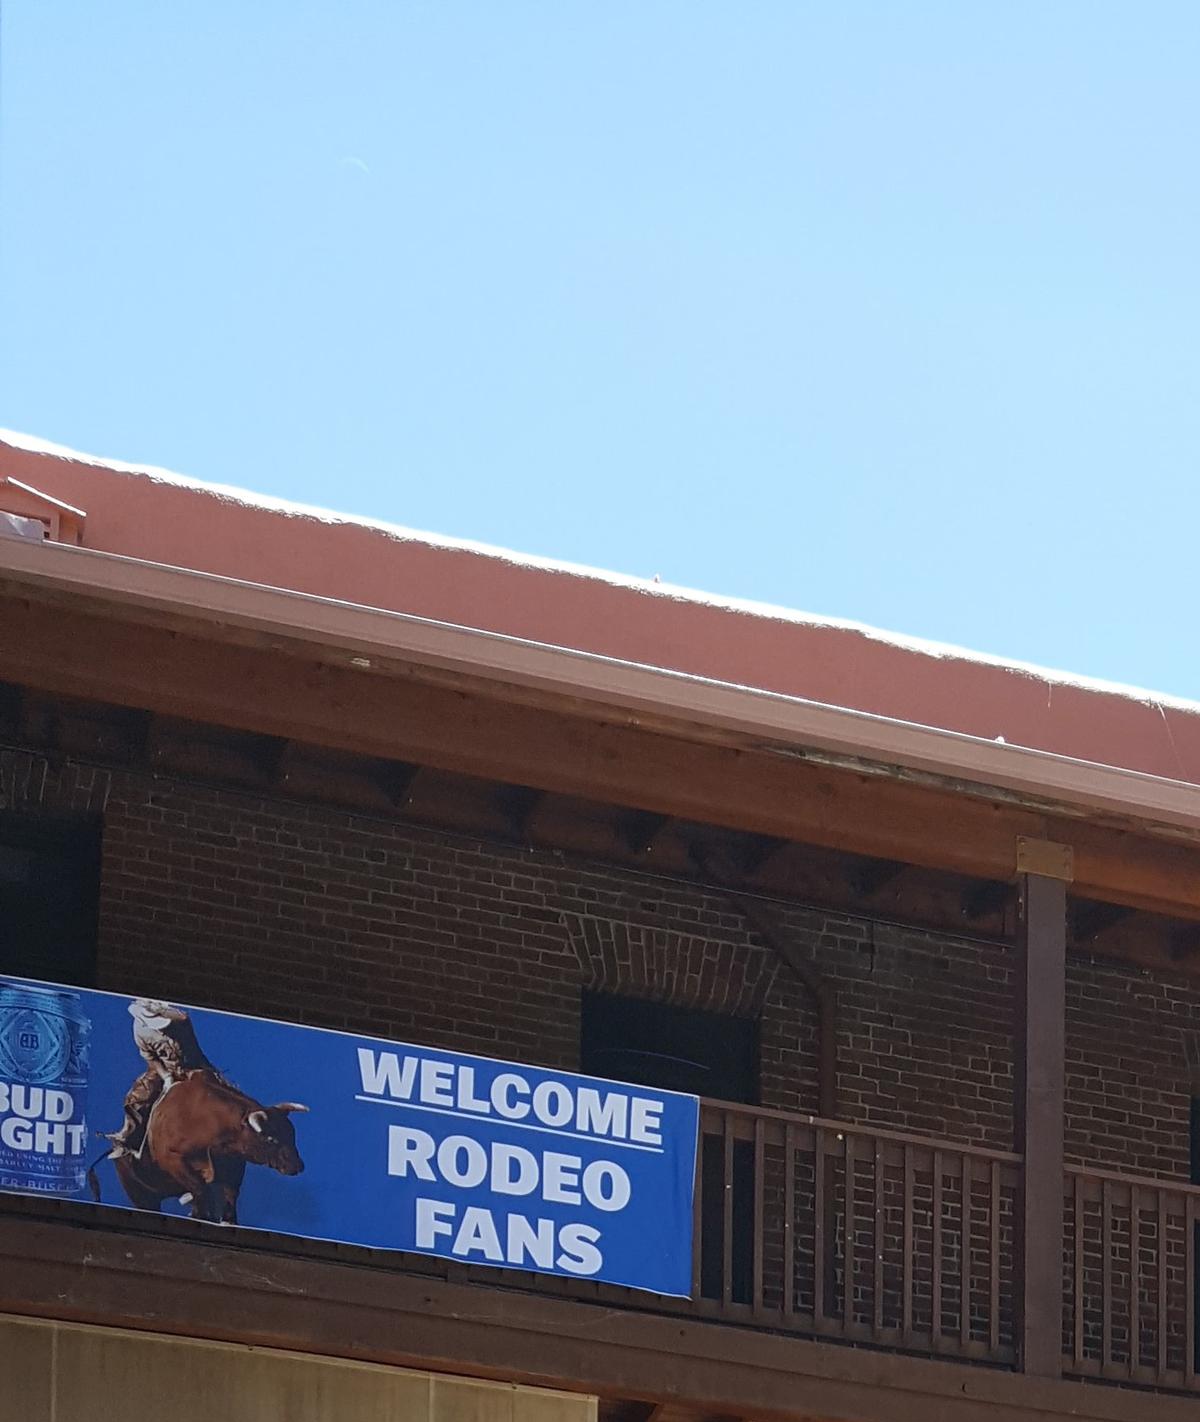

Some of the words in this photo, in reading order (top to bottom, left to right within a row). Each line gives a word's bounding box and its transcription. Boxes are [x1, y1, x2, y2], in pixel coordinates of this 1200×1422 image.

[356, 1048, 664, 1146] WELCOME
[387, 1124, 631, 1212] RODEO
[415, 1197, 603, 1275] FANS
